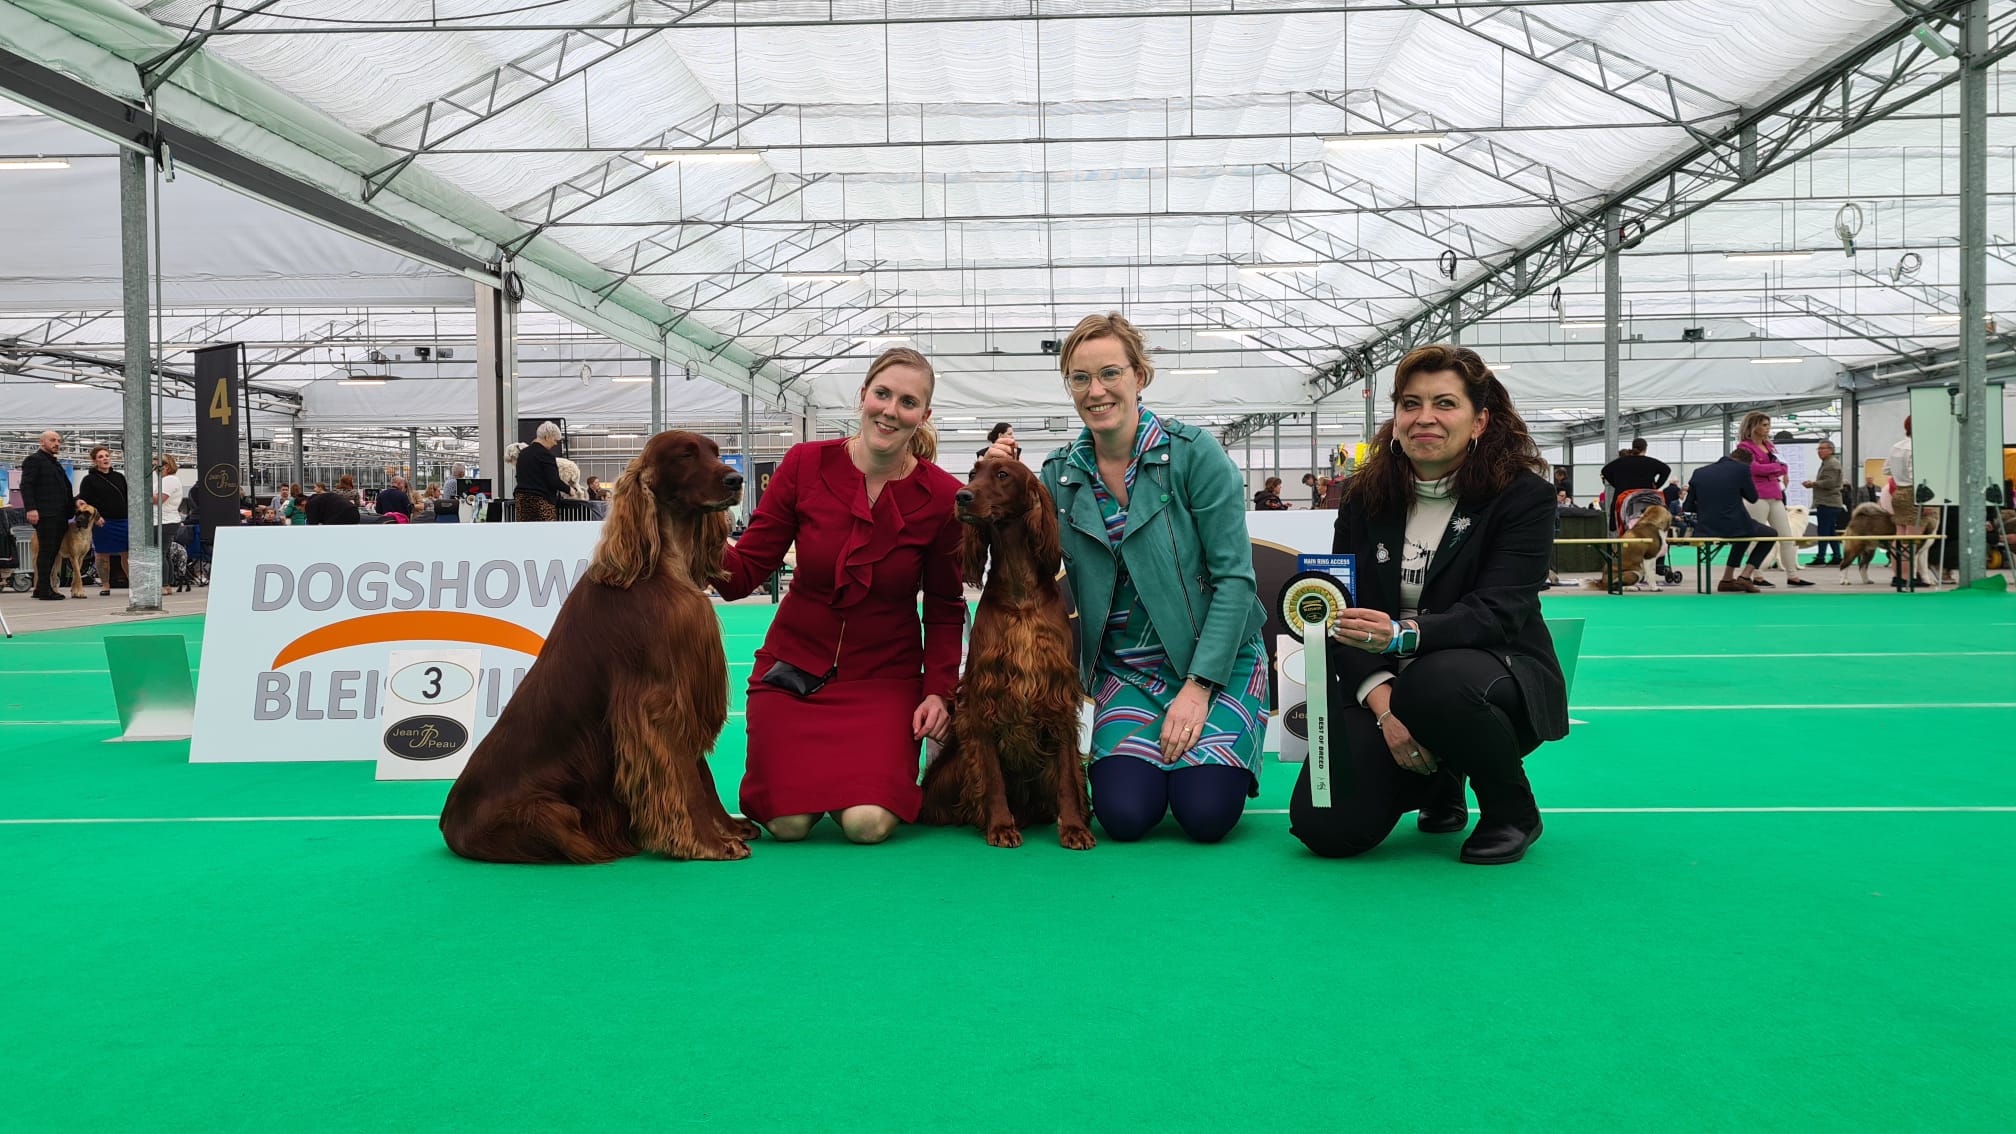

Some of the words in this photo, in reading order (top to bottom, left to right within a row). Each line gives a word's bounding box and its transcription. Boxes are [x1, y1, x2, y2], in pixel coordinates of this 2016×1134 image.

[209, 378, 232, 425] 4
[761, 473, 770, 491] 8
[251, 559, 589, 612] DOGSHOW
[254, 667, 526, 721] BLEII
[422, 666, 443, 699] 3
[392, 728, 419, 737] Jean
[428, 739, 456, 749] Peau
[1318, 734, 1325, 745] OF
